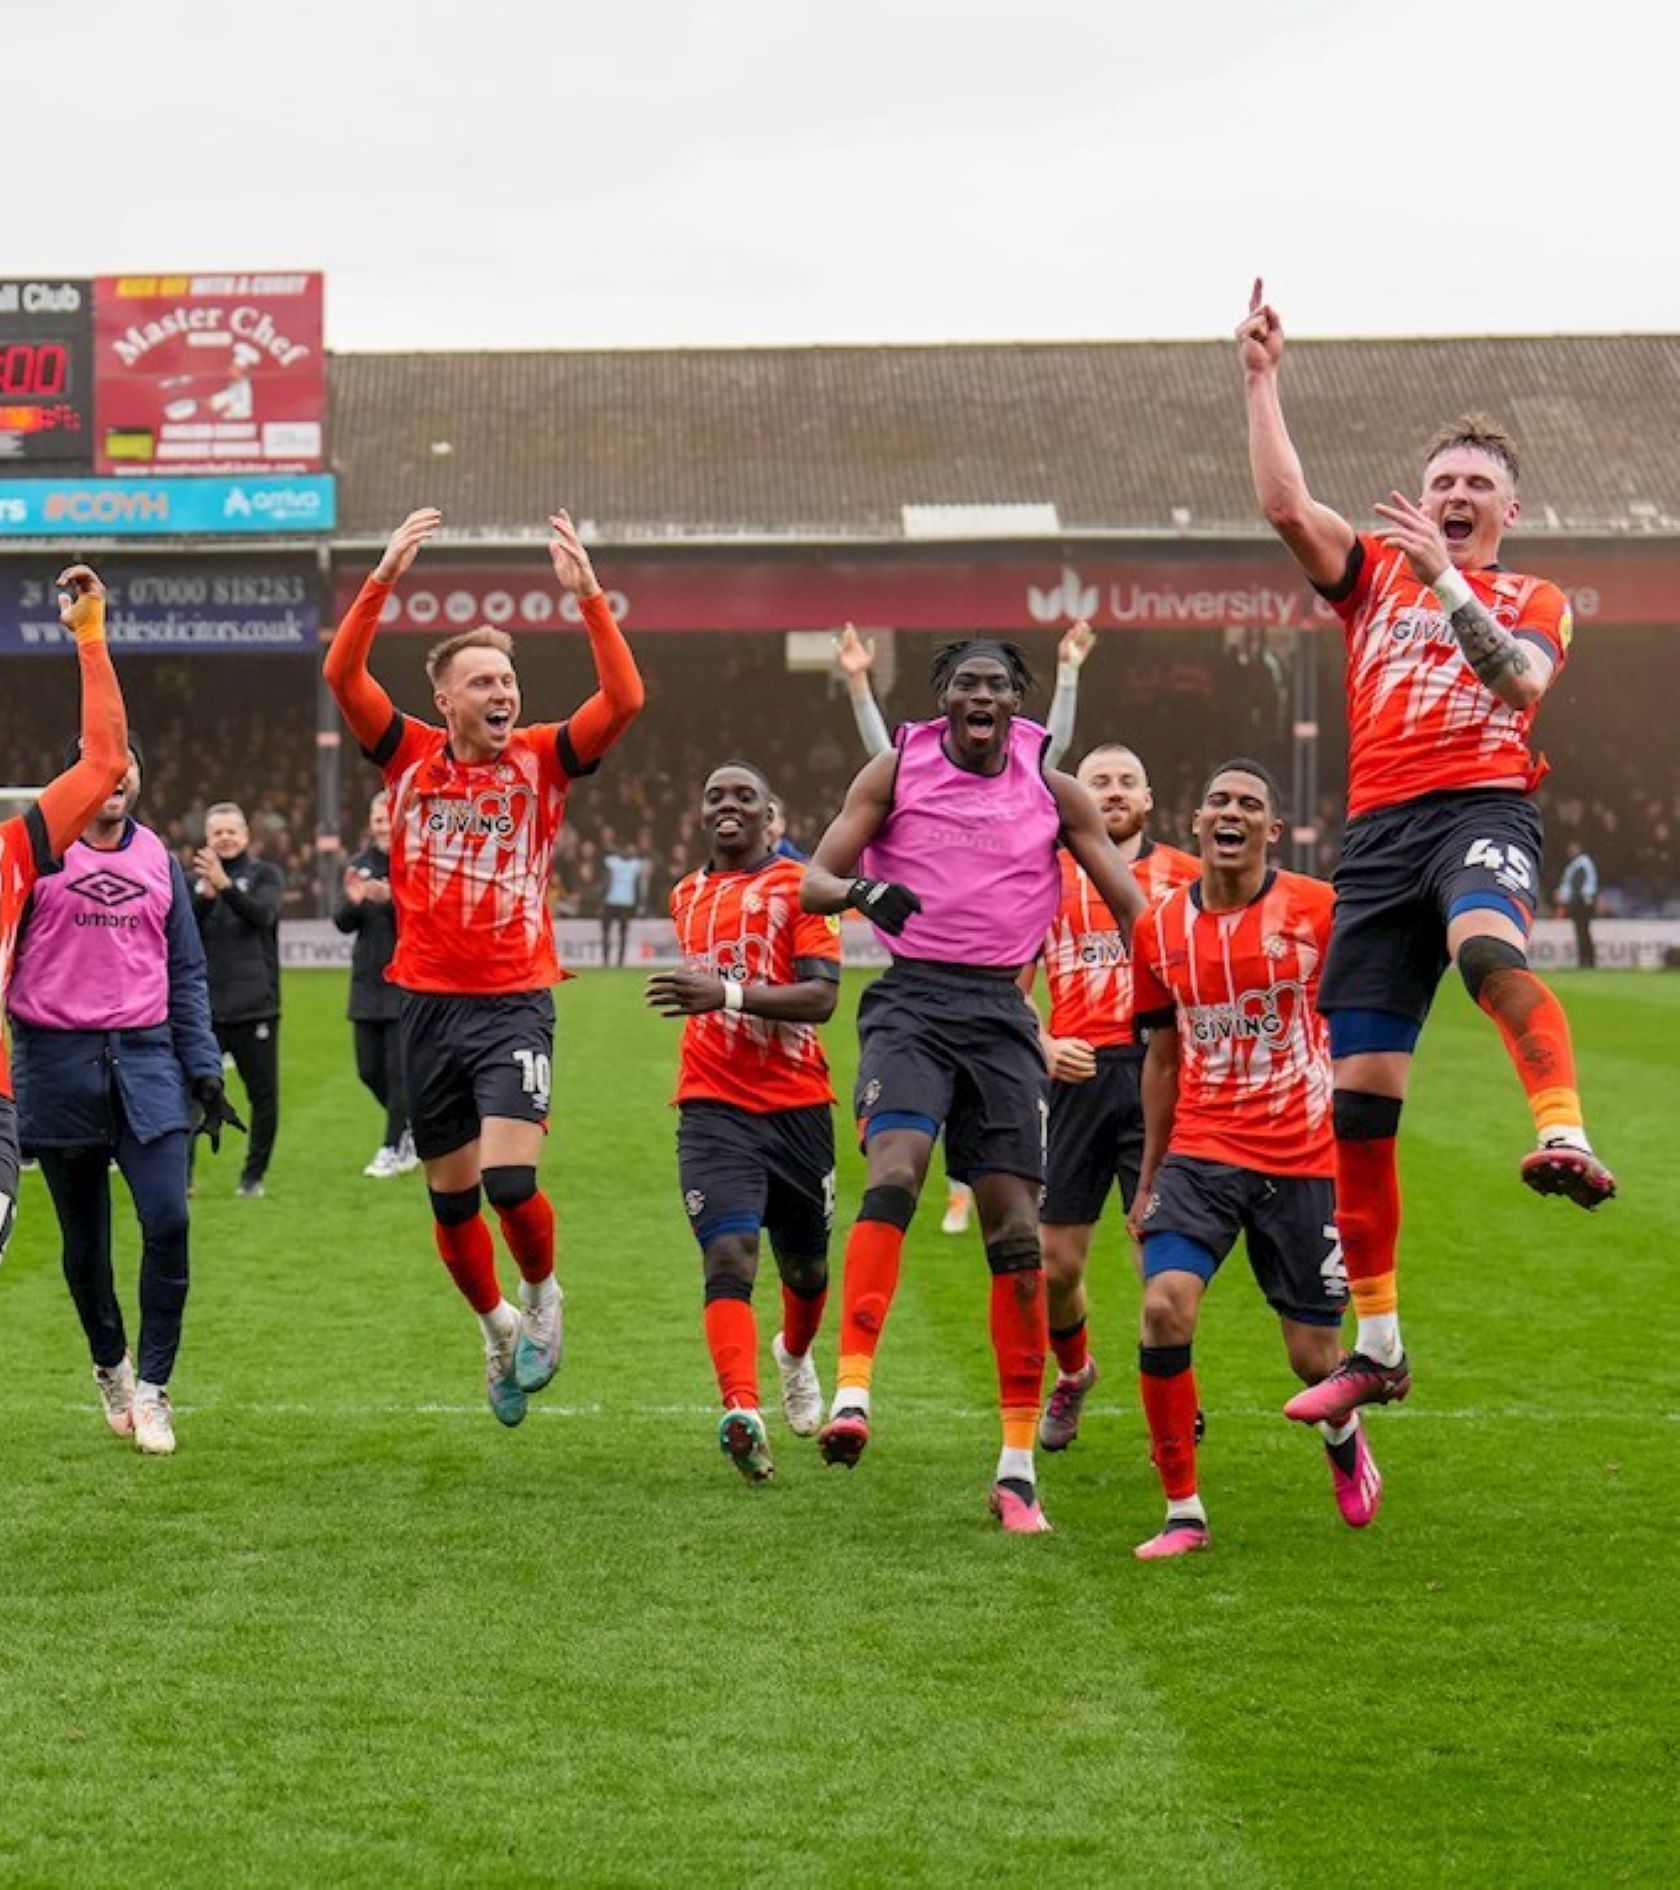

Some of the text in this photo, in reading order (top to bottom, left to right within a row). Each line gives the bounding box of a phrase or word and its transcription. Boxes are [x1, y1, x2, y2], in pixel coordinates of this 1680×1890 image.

[22, 282, 82, 313] Club
[112, 304, 311, 368] Master Chef
[43, 490, 169, 522] #COYH
[128, 576, 207, 606] 07000
[211, 575, 306, 604] 818283
[1109, 583, 1296, 624] University
[428, 813, 513, 833] GIVING
[1463, 837, 1532, 890] 45
[74, 911, 142, 930] umbro
[1193, 1013, 1281, 1041] GIVING
[512, 1050, 551, 1099] 10
